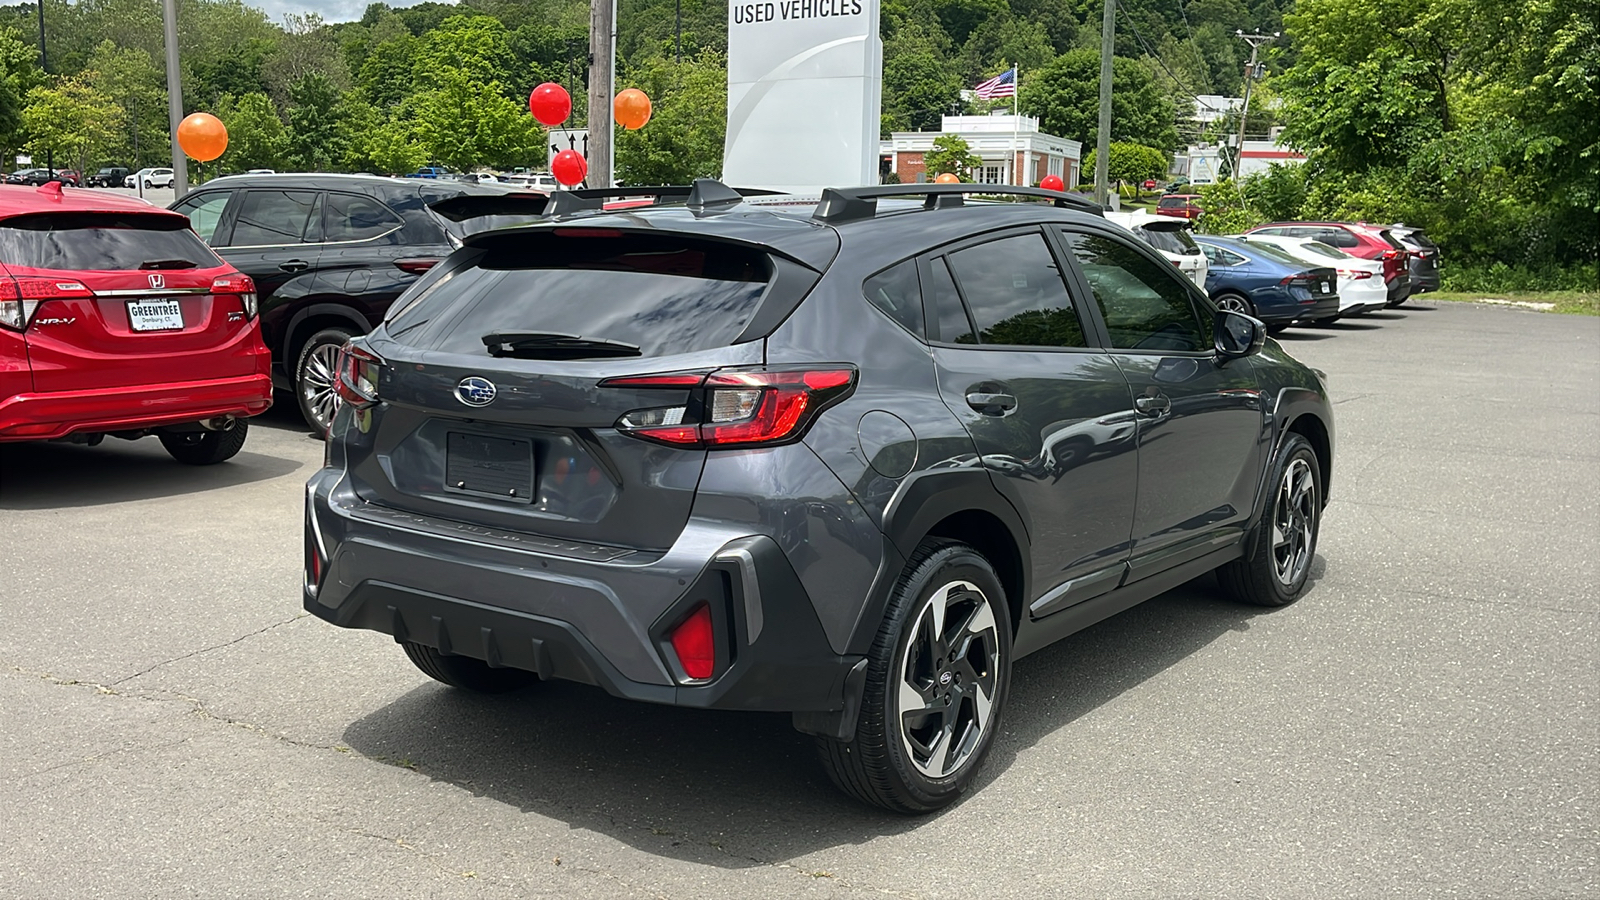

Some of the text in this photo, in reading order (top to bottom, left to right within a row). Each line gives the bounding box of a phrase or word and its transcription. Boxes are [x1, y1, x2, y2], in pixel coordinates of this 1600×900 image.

[735, 0, 862, 24] USED VEHICLES
[131, 305, 179, 317] GREENTREE
